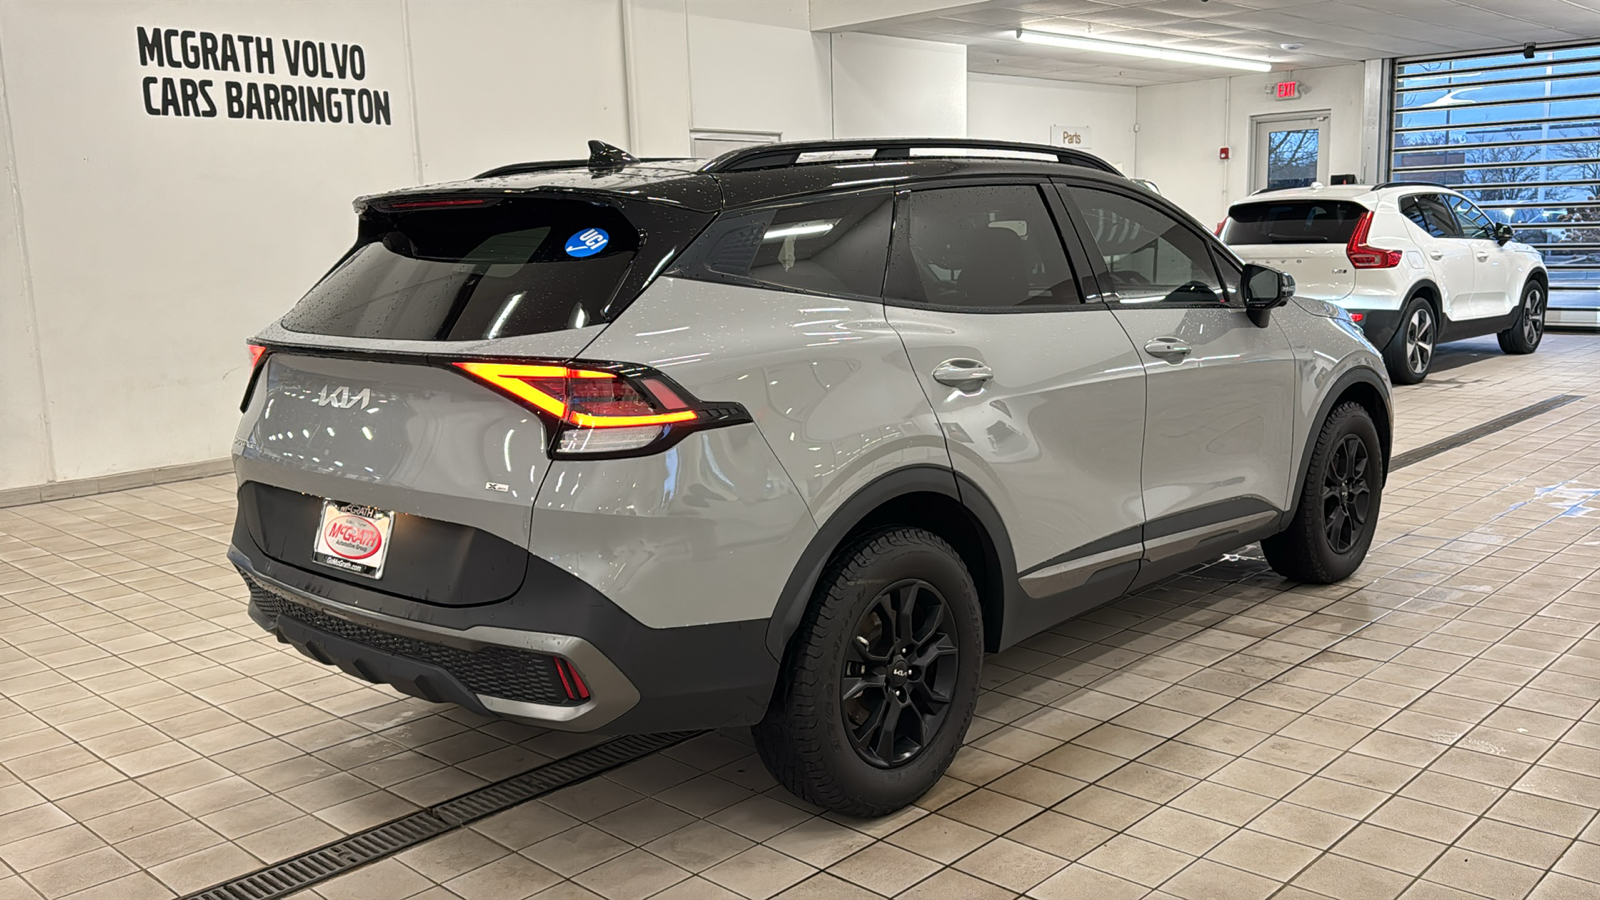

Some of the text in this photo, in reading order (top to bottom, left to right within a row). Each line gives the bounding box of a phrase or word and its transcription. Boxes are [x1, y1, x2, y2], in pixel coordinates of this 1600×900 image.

[136, 26, 366, 81] MCGRATH VOLVO
[142, 76, 392, 126] CARS BARRINGTON
[1277, 81, 1296, 98] EXIT
[1062, 131, 1082, 144] Parts
[579, 228, 608, 250] UCI
[318, 384, 371, 410] KIA
